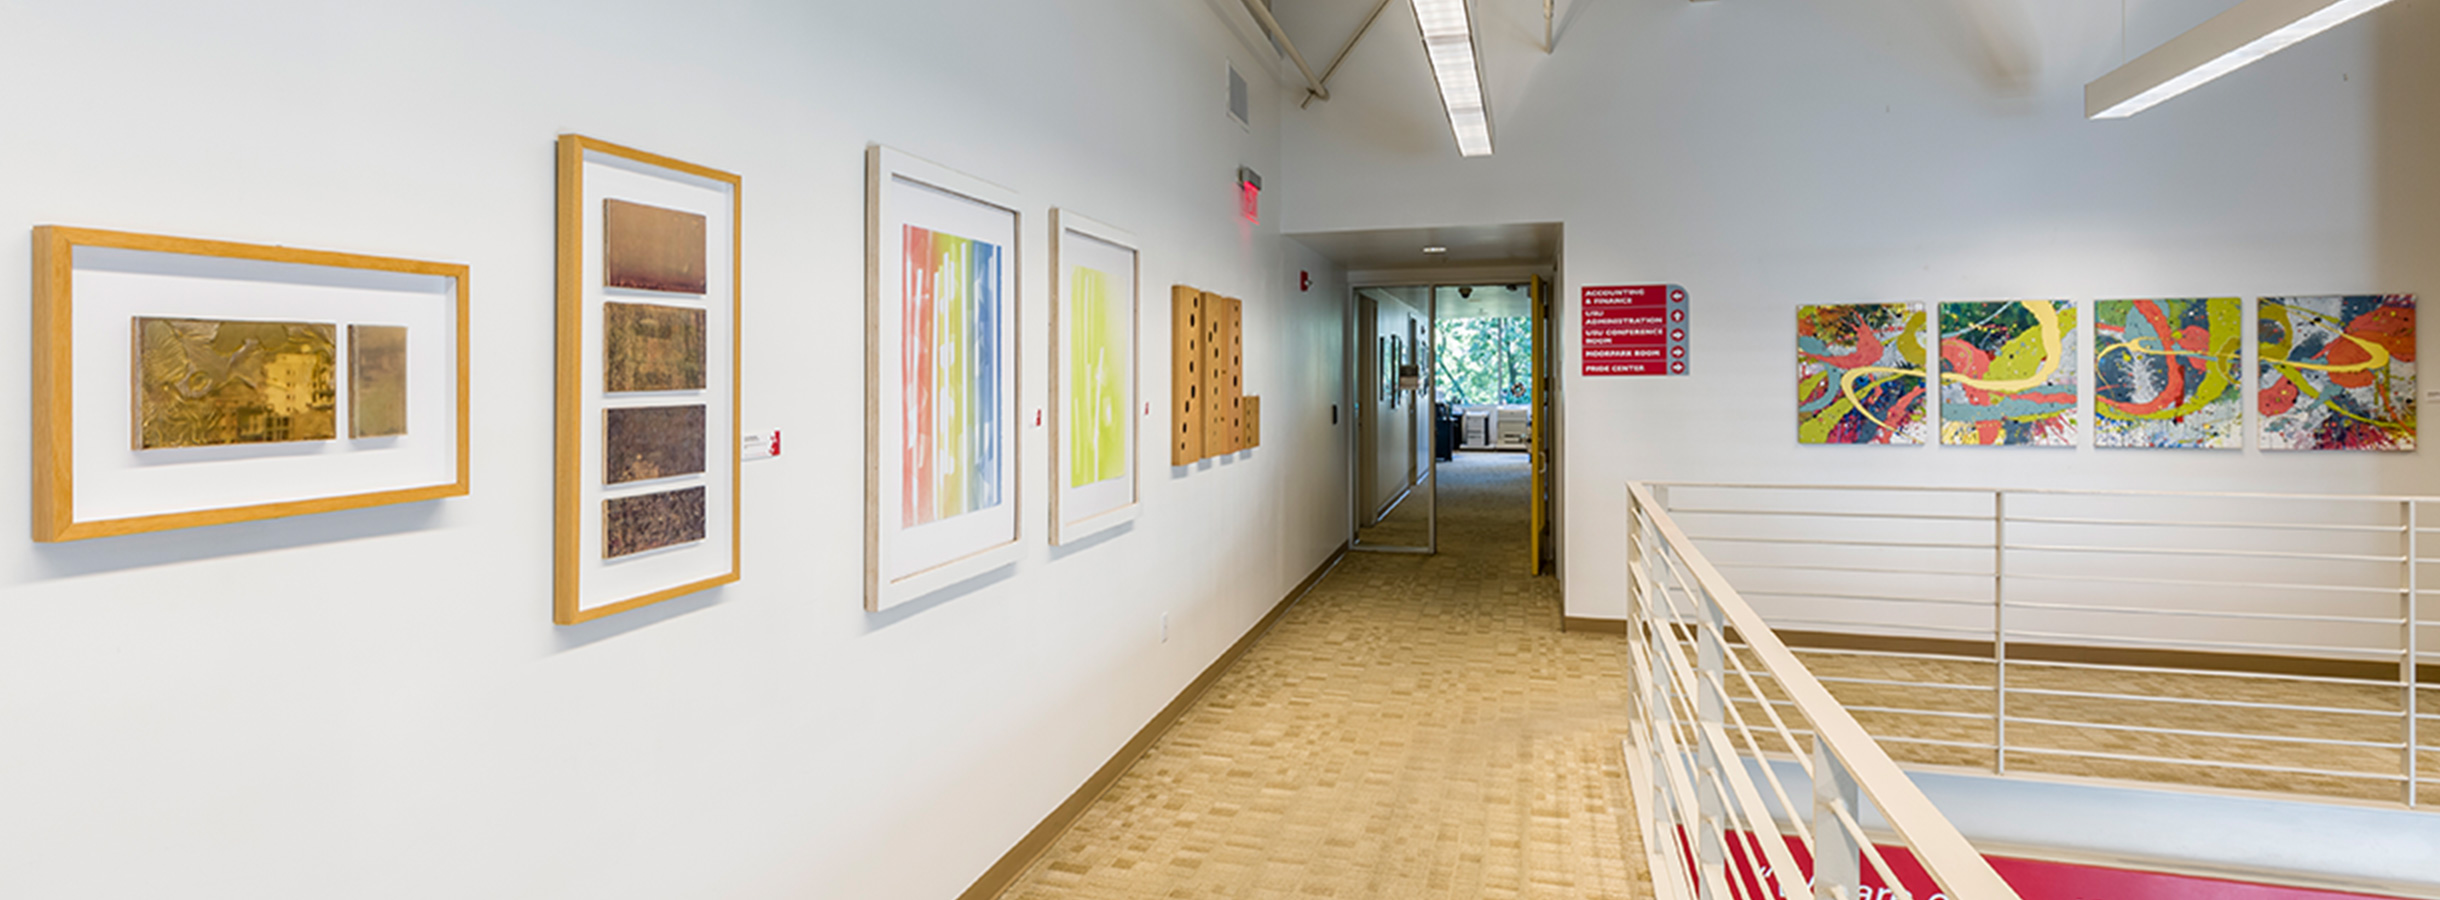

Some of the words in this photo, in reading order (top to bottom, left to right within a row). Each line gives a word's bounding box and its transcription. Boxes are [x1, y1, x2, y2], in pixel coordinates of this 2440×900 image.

[1585, 288, 1645, 297] ACCOUNTING
[1585, 317, 1663, 325] ADMINISTRATION
[1605, 328, 1663, 336] CONFERENCE
[1611, 364, 1645, 372] CENTER
